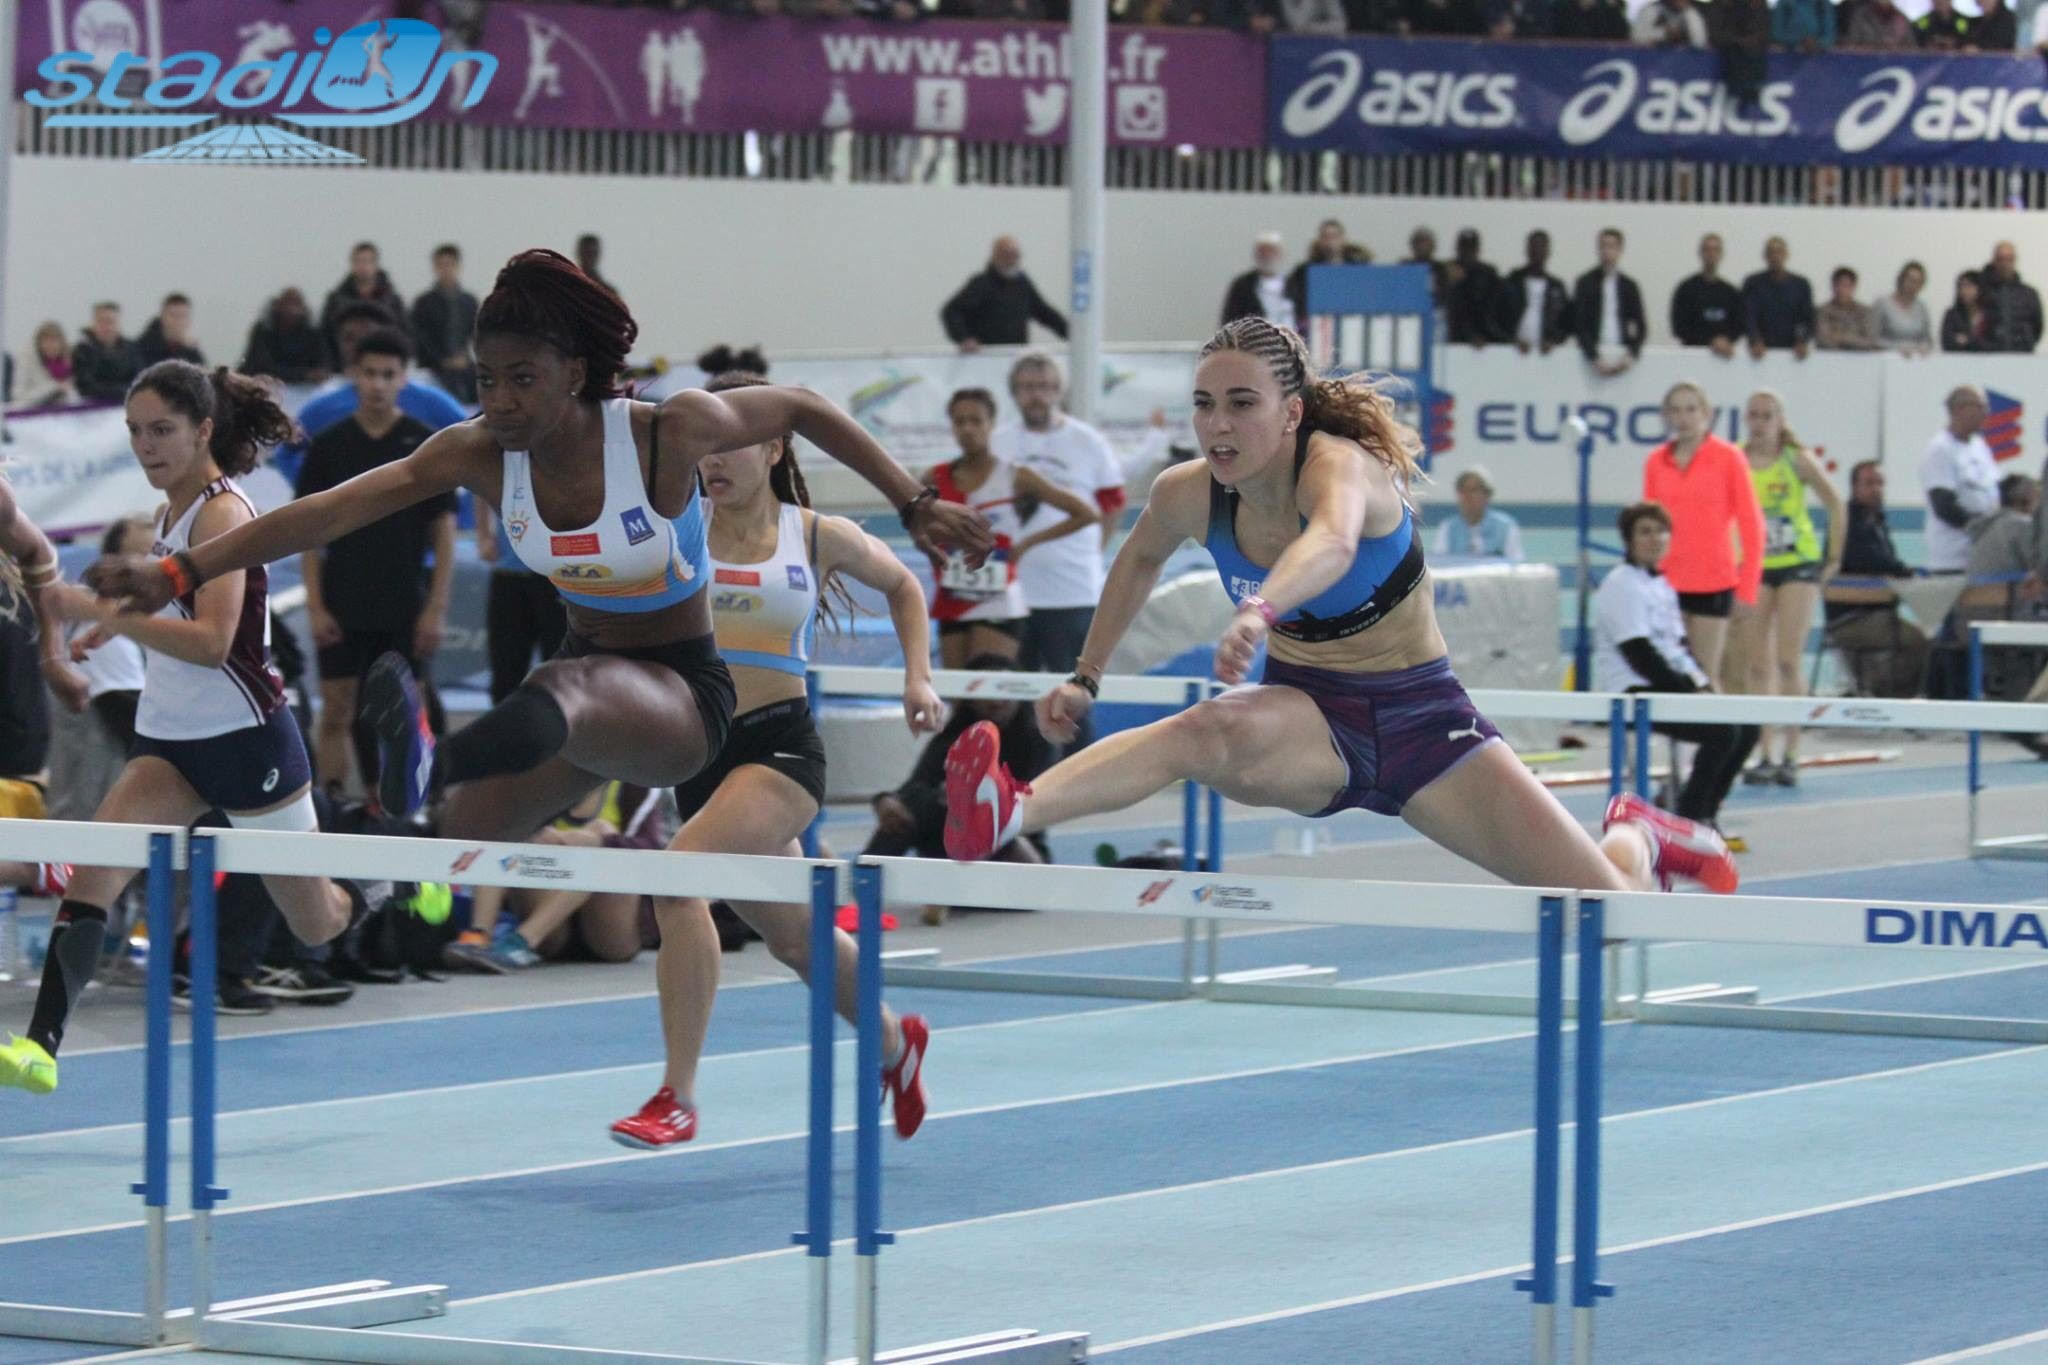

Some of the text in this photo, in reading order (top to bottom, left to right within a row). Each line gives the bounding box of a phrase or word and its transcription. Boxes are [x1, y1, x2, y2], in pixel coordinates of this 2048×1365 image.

[821, 33, 1166, 81] www.athl.fr
[1358, 70, 1518, 128] asics
[1866, 907, 2048, 949] DIMA
